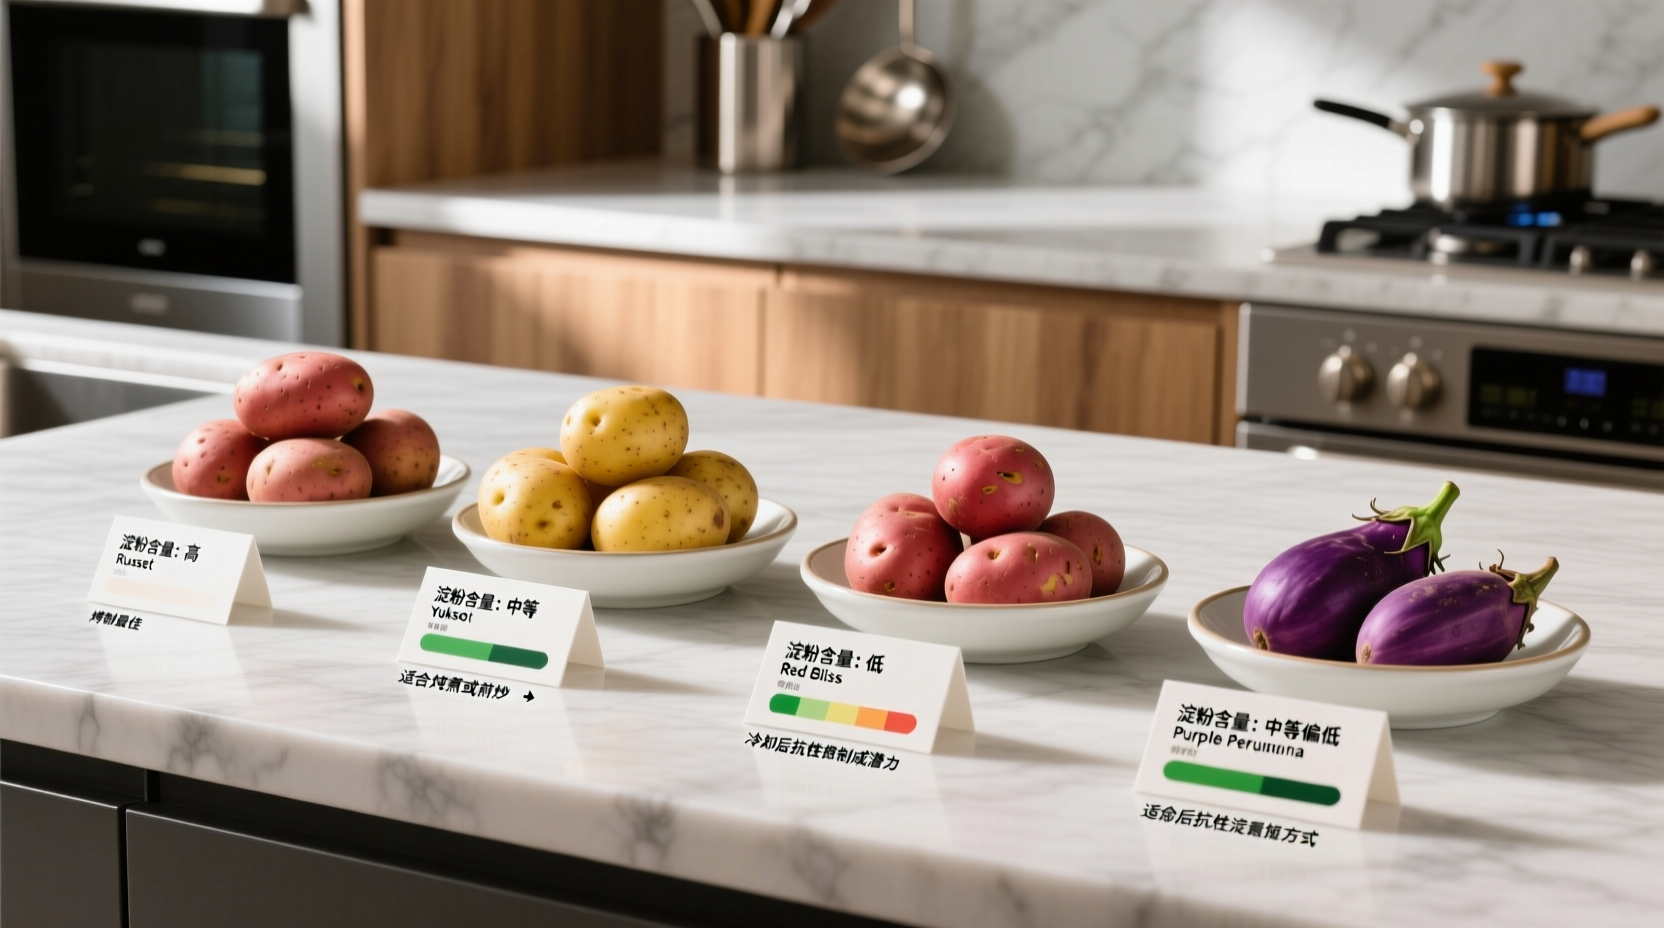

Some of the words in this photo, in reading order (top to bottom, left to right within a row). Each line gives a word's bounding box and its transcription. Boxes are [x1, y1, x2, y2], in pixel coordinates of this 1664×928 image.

[115, 553, 154, 570] Russet
[780, 662, 808, 678] Red
[810, 667, 843, 684] Bliss
[1173, 725, 1222, 747] Purple
